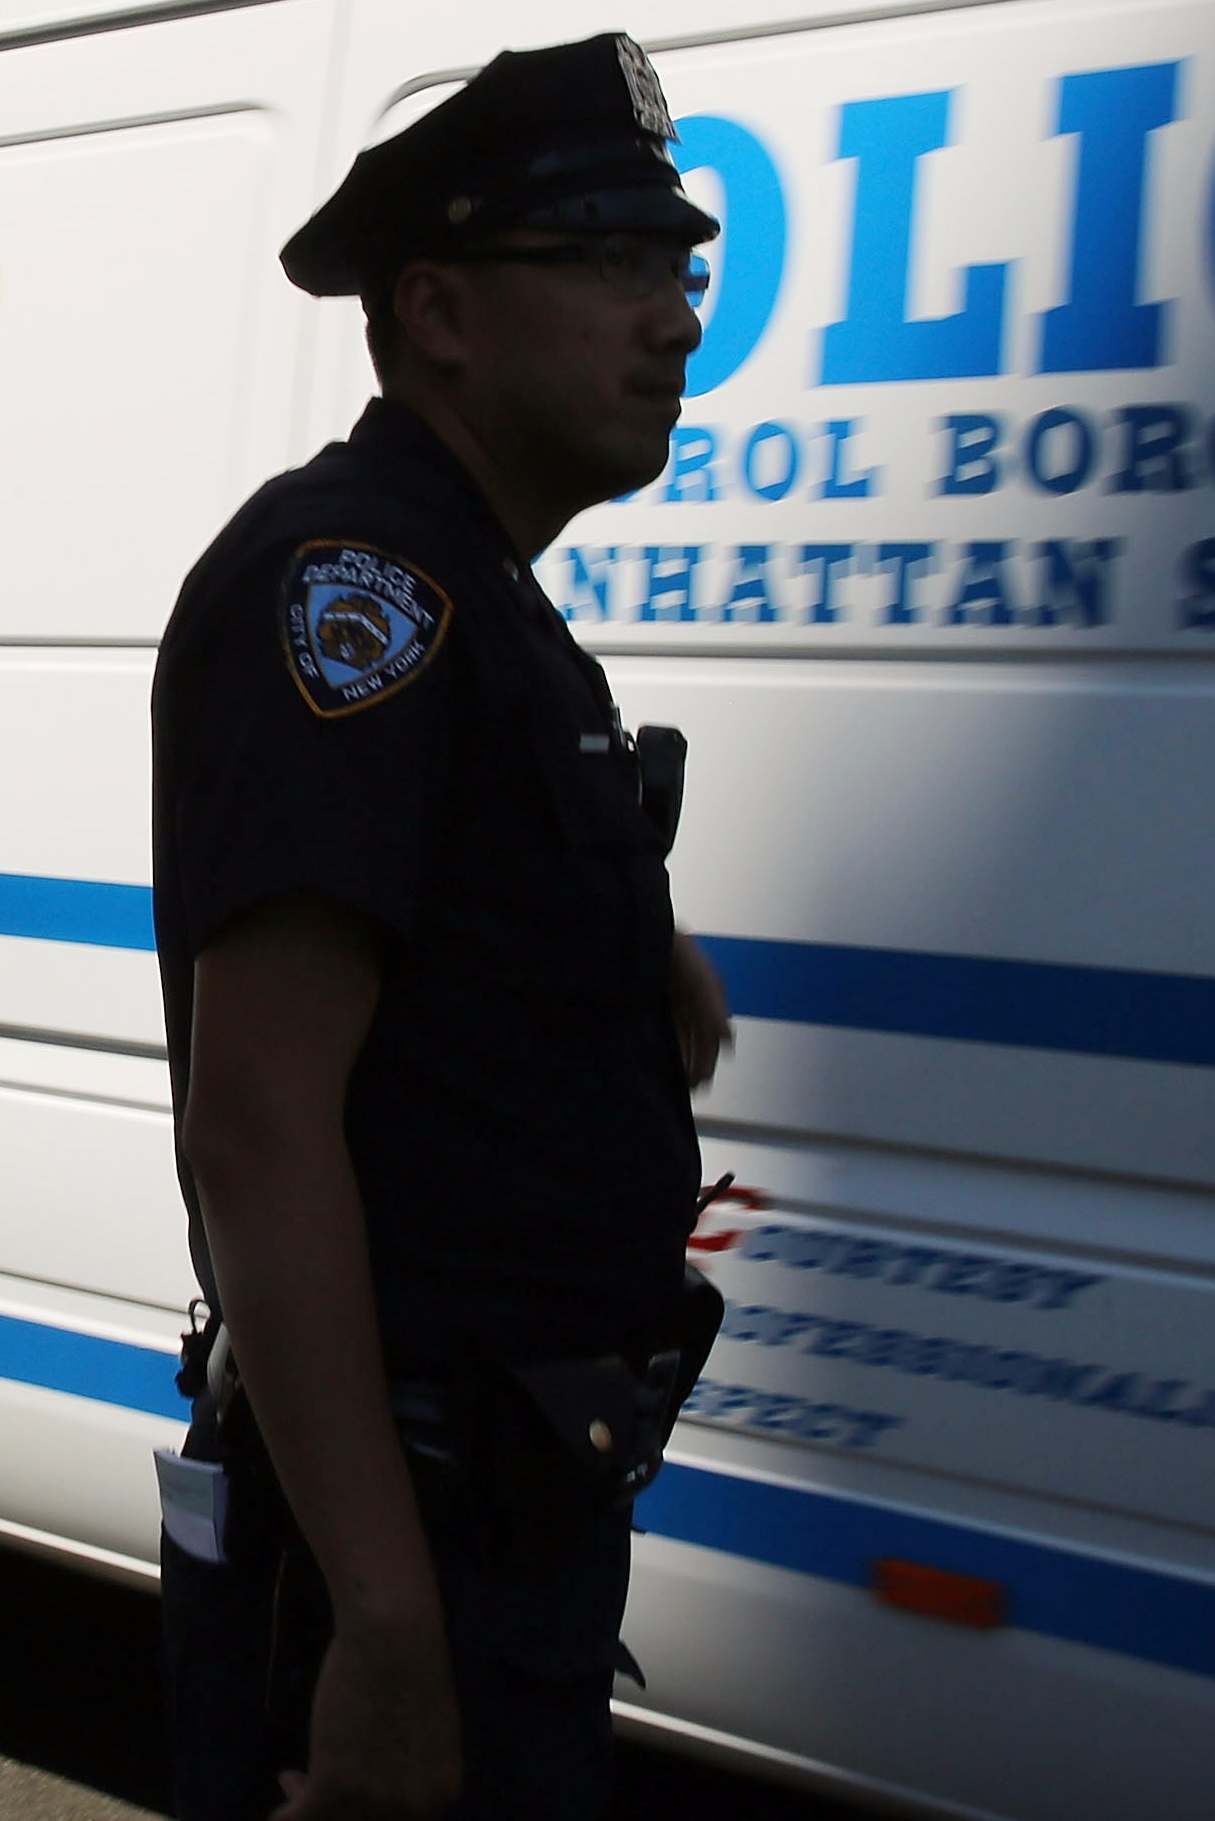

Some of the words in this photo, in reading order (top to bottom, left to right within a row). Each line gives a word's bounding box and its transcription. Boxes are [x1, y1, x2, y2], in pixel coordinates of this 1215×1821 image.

[670, 58, 1215, 399] OLI
[612, 418, 882, 503] ROL
[936, 405, 1215, 498] BOR
[301, 563, 435, 631] DEPARTMENT
[339, 548, 417, 596] POLICE
[560, 538, 1124, 630] NHATTAN
[342, 674, 384, 702] NEW
[385, 639, 426, 680] YORK
